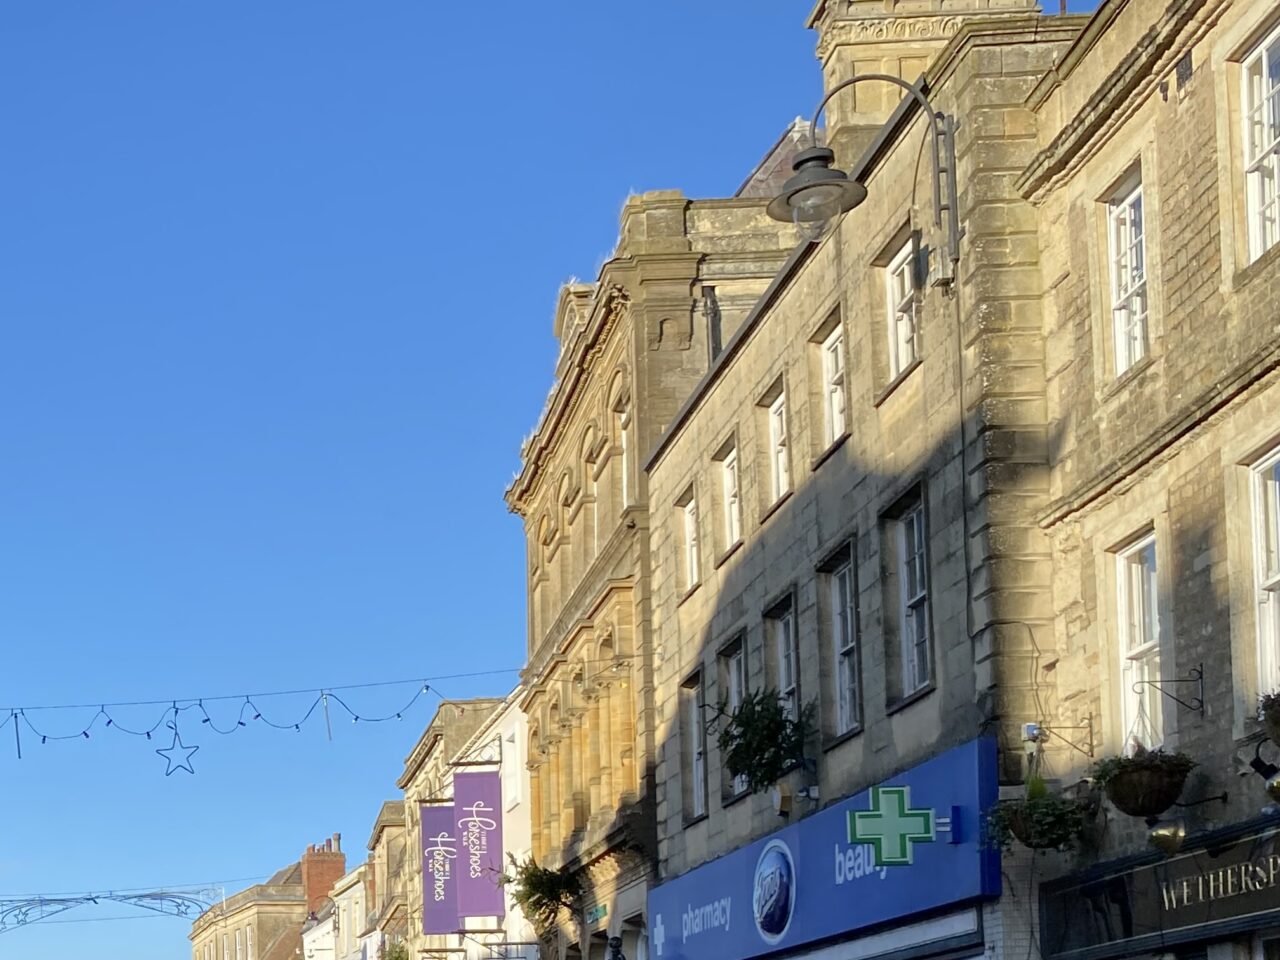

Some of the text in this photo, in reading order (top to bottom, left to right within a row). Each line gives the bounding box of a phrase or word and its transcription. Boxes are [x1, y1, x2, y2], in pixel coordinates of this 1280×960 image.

[424, 832, 457, 902] Horseshoes
[458, 800, 497, 878] Horseshoes
[835, 843, 888, 886] beau
[681, 896, 731, 944] pharmacy
